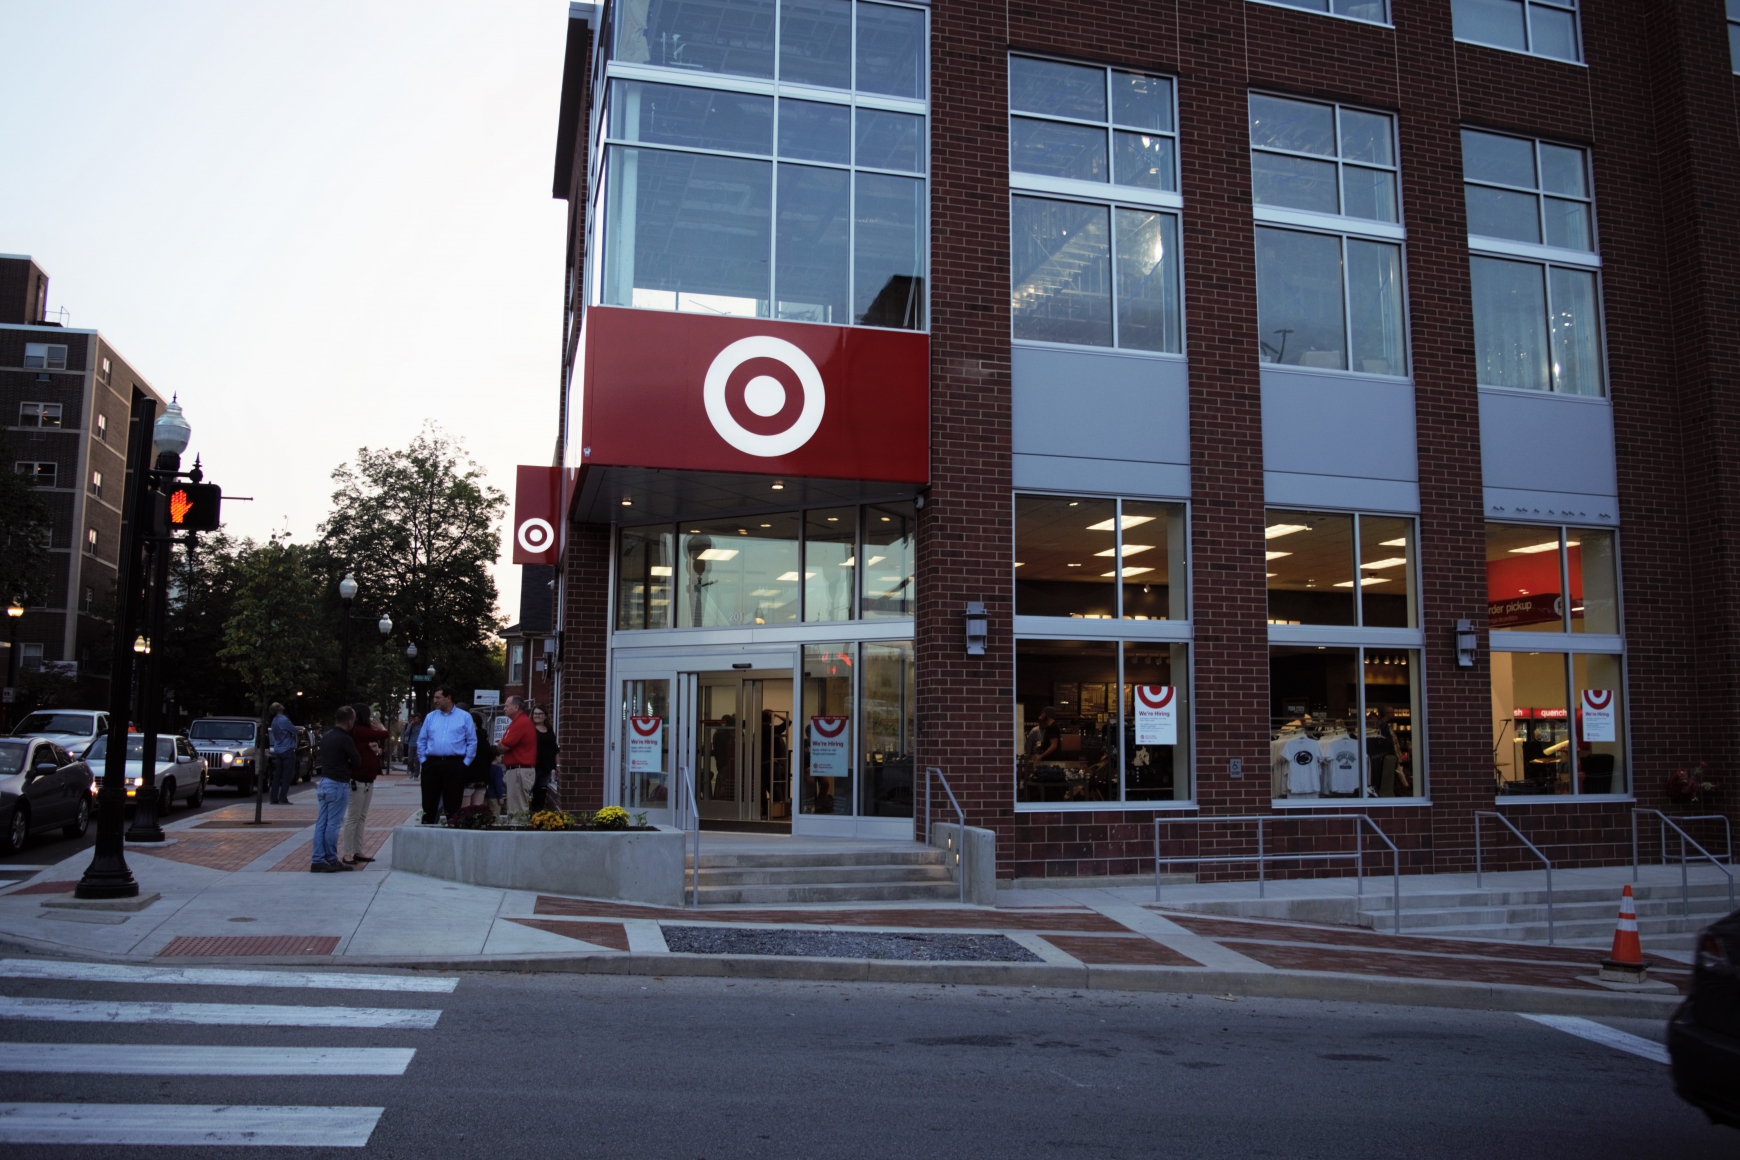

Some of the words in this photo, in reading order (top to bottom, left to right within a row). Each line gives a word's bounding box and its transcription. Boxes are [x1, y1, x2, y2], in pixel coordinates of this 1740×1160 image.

[1488, 604, 1504, 614] rder
[1506, 601, 1532, 614] pickup
[730, 612, 743, 621] 201
[1541, 708, 1567, 718] quench
